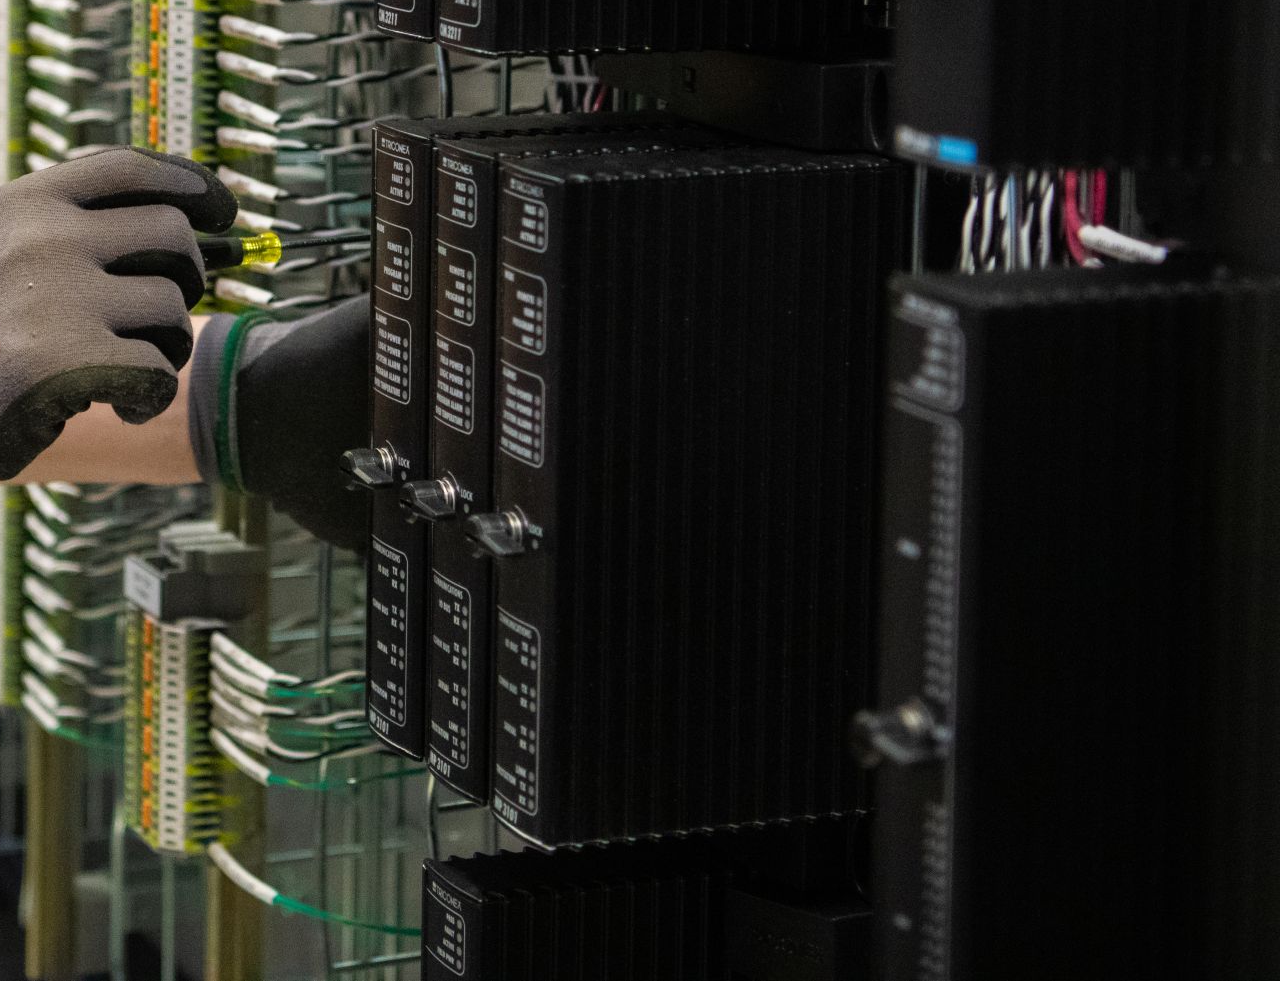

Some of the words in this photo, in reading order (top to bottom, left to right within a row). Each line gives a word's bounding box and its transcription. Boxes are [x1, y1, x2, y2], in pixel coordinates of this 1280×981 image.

[398, 457, 410, 469] LOCK
[461, 489, 472, 501] LOCK
[437, 759, 450, 778] 3101
[503, 803, 518, 823] 3101
